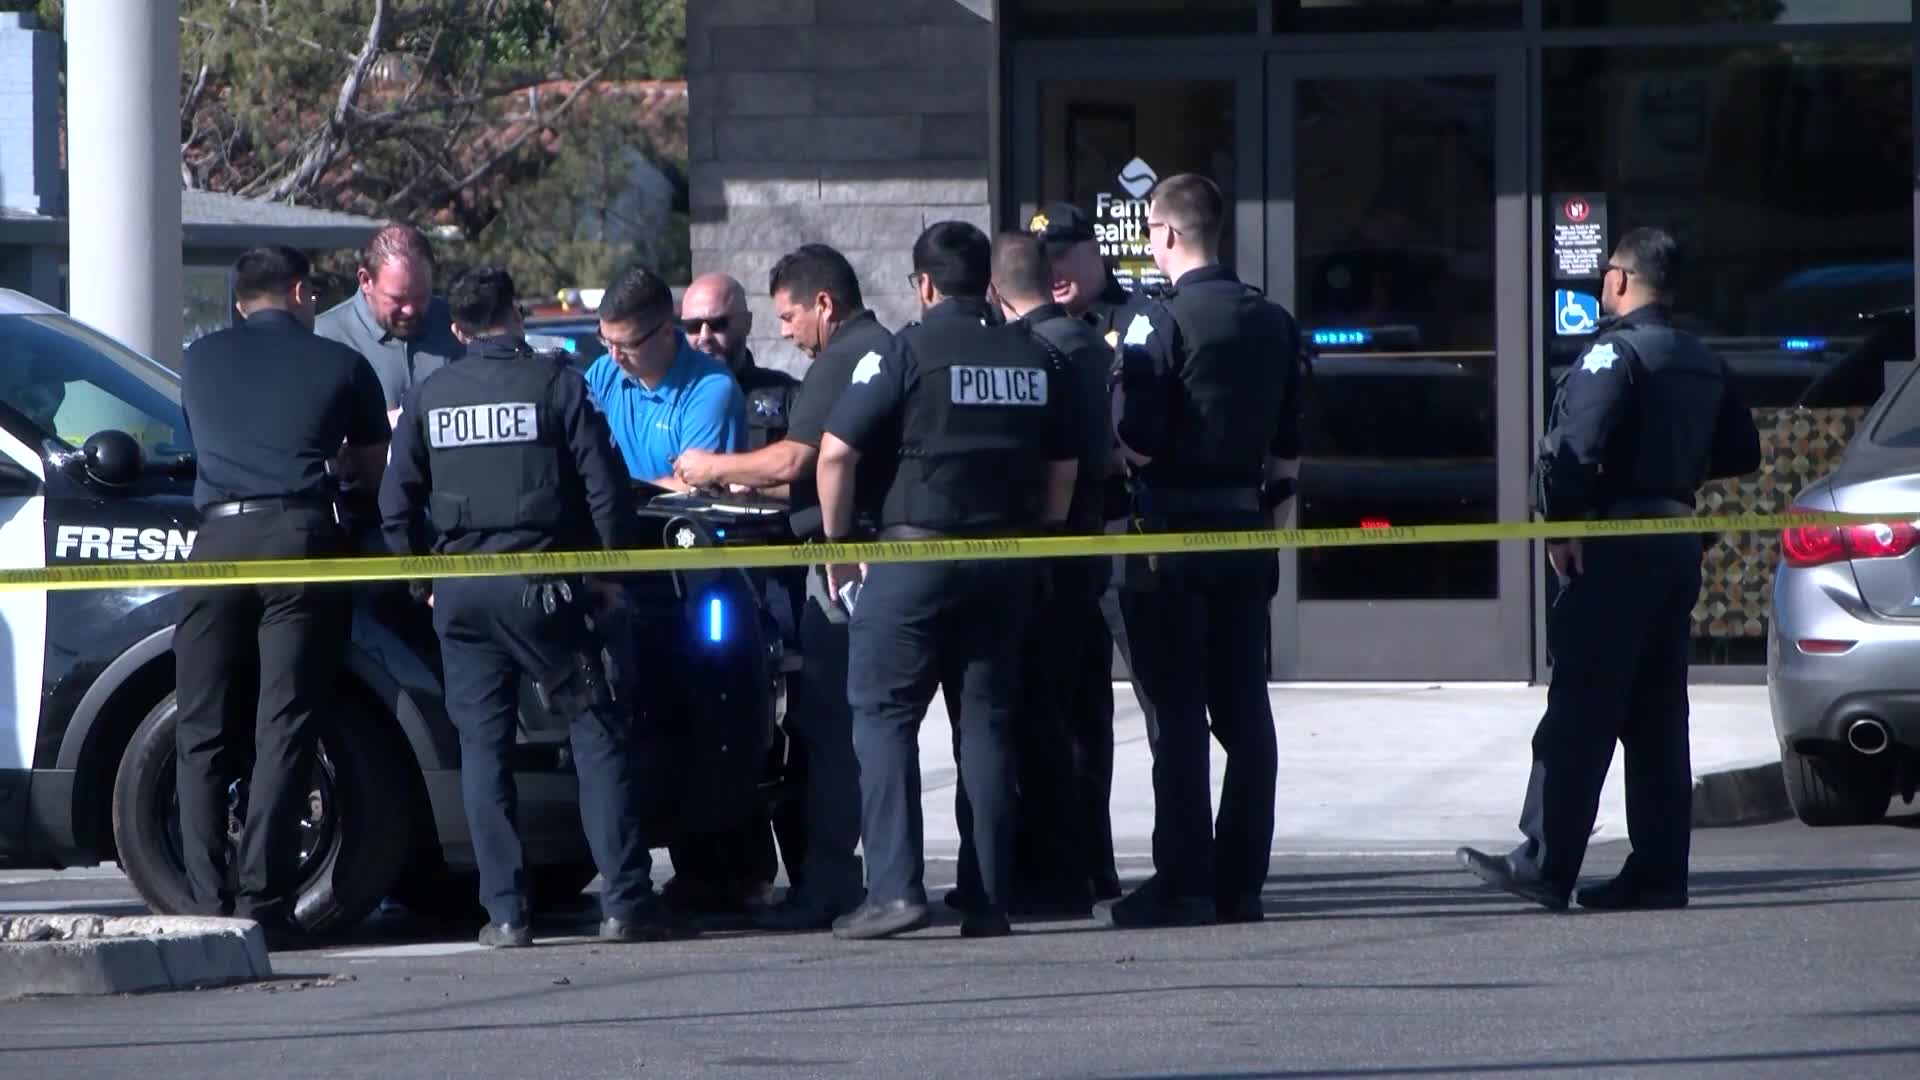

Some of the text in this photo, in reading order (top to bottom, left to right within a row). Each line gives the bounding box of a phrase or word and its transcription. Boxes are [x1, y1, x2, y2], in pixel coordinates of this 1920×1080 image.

[1096, 192, 1150, 218] Fam
[1099, 243, 1153, 256] NETWO
[960, 368, 1040, 401] POLICE
[437, 405, 529, 443] POLICE
[55, 525, 198, 561] FRESN
